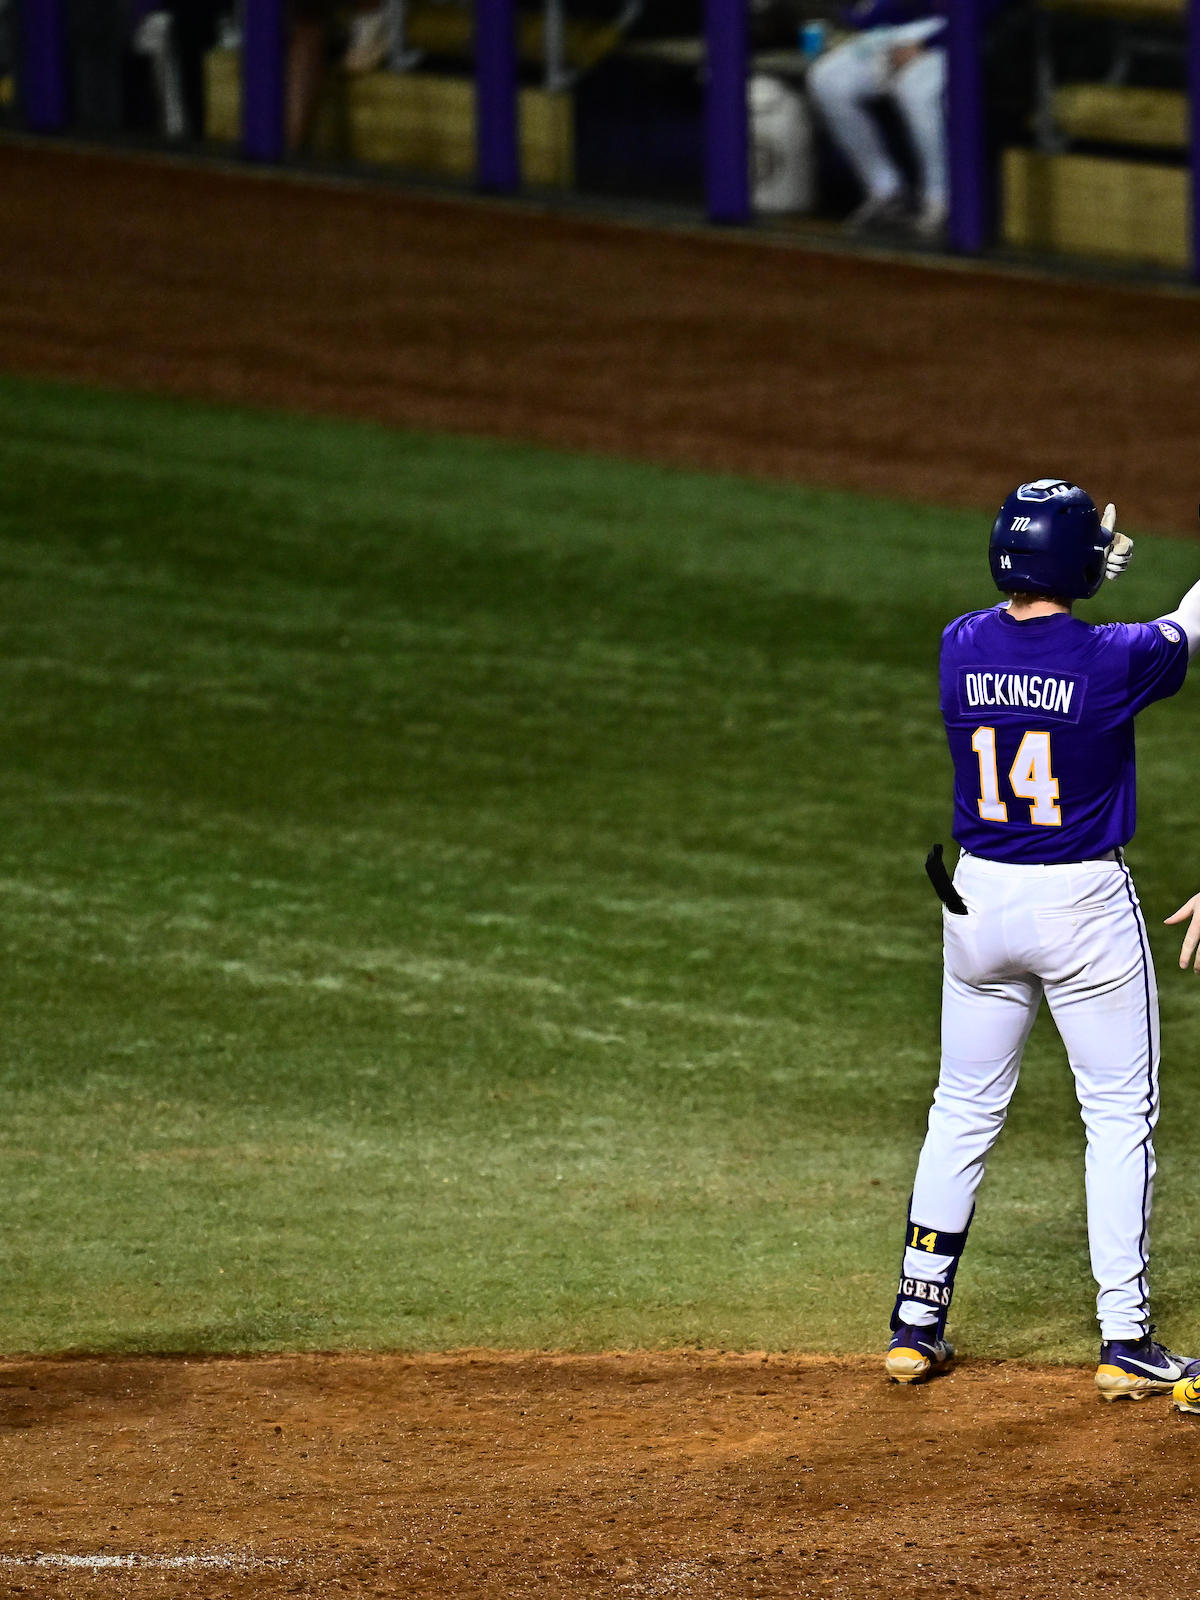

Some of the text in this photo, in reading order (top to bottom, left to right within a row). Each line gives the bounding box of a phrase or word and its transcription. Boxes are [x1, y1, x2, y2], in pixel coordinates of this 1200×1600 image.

[999, 554, 1012, 570] 14
[965, 672, 1075, 714] DICKINSON
[971, 725, 1063, 827] 14
[911, 1226, 938, 1253] 14
